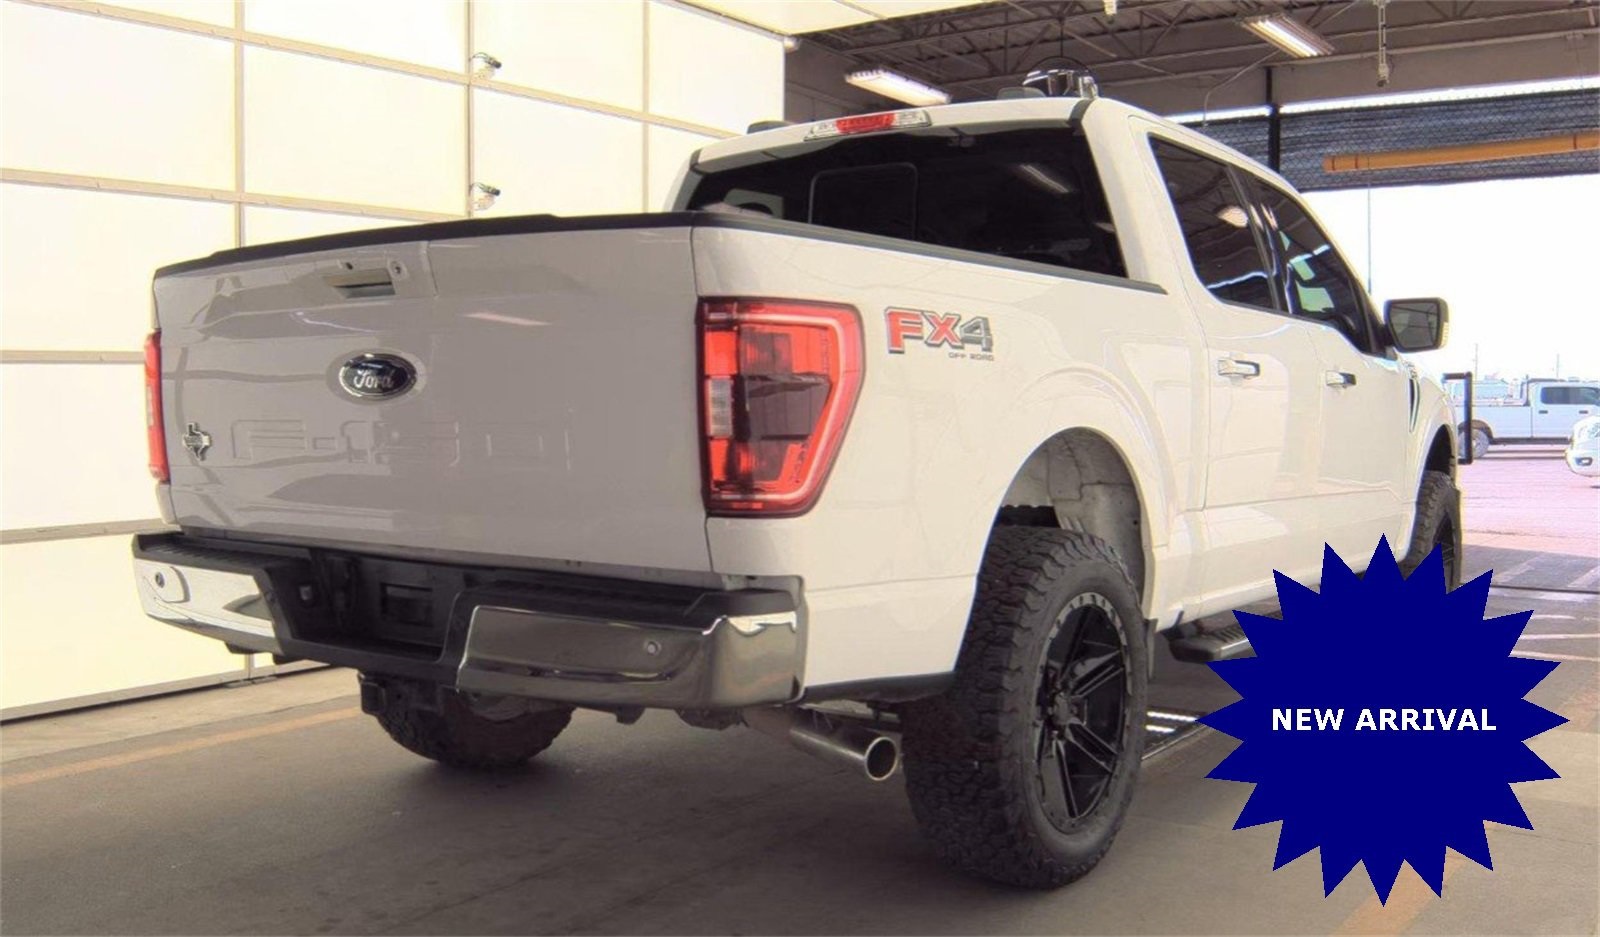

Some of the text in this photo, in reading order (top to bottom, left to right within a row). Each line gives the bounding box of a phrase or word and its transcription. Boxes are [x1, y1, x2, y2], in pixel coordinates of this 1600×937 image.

[884, 306, 994, 354] FX4
[353, 368, 396, 388] Ford
[230, 419, 573, 474] F-150
